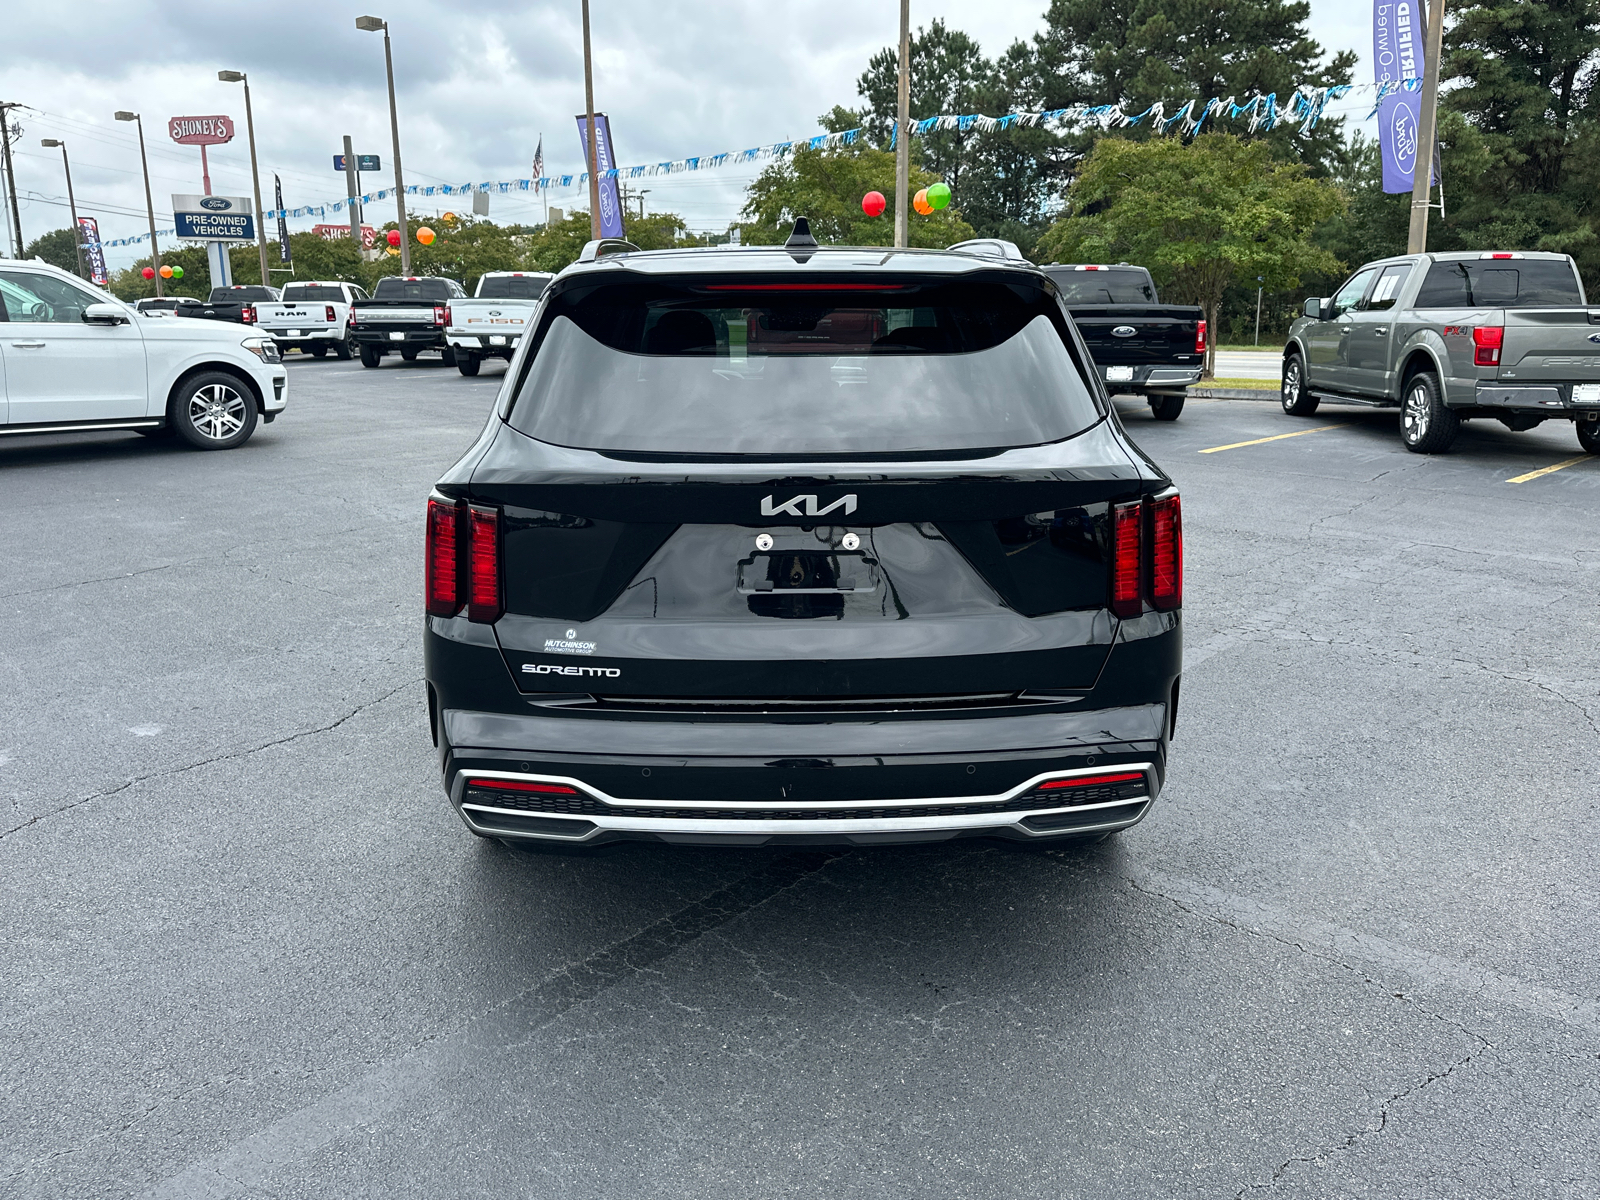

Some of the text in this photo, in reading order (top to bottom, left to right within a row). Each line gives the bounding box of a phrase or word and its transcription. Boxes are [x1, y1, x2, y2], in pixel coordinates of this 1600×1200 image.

[172, 118, 227, 139] SHONEY'S
[208, 200, 226, 208] Ford
[185, 215, 247, 226] PRE-OWNED
[193, 226, 244, 236] VEHICLES
[1443, 326, 1468, 336] FX4
[760, 494, 858, 516] KIA
[544, 640, 595, 649] HUTCHINSON
[521, 663, 621, 678] SORENTO
